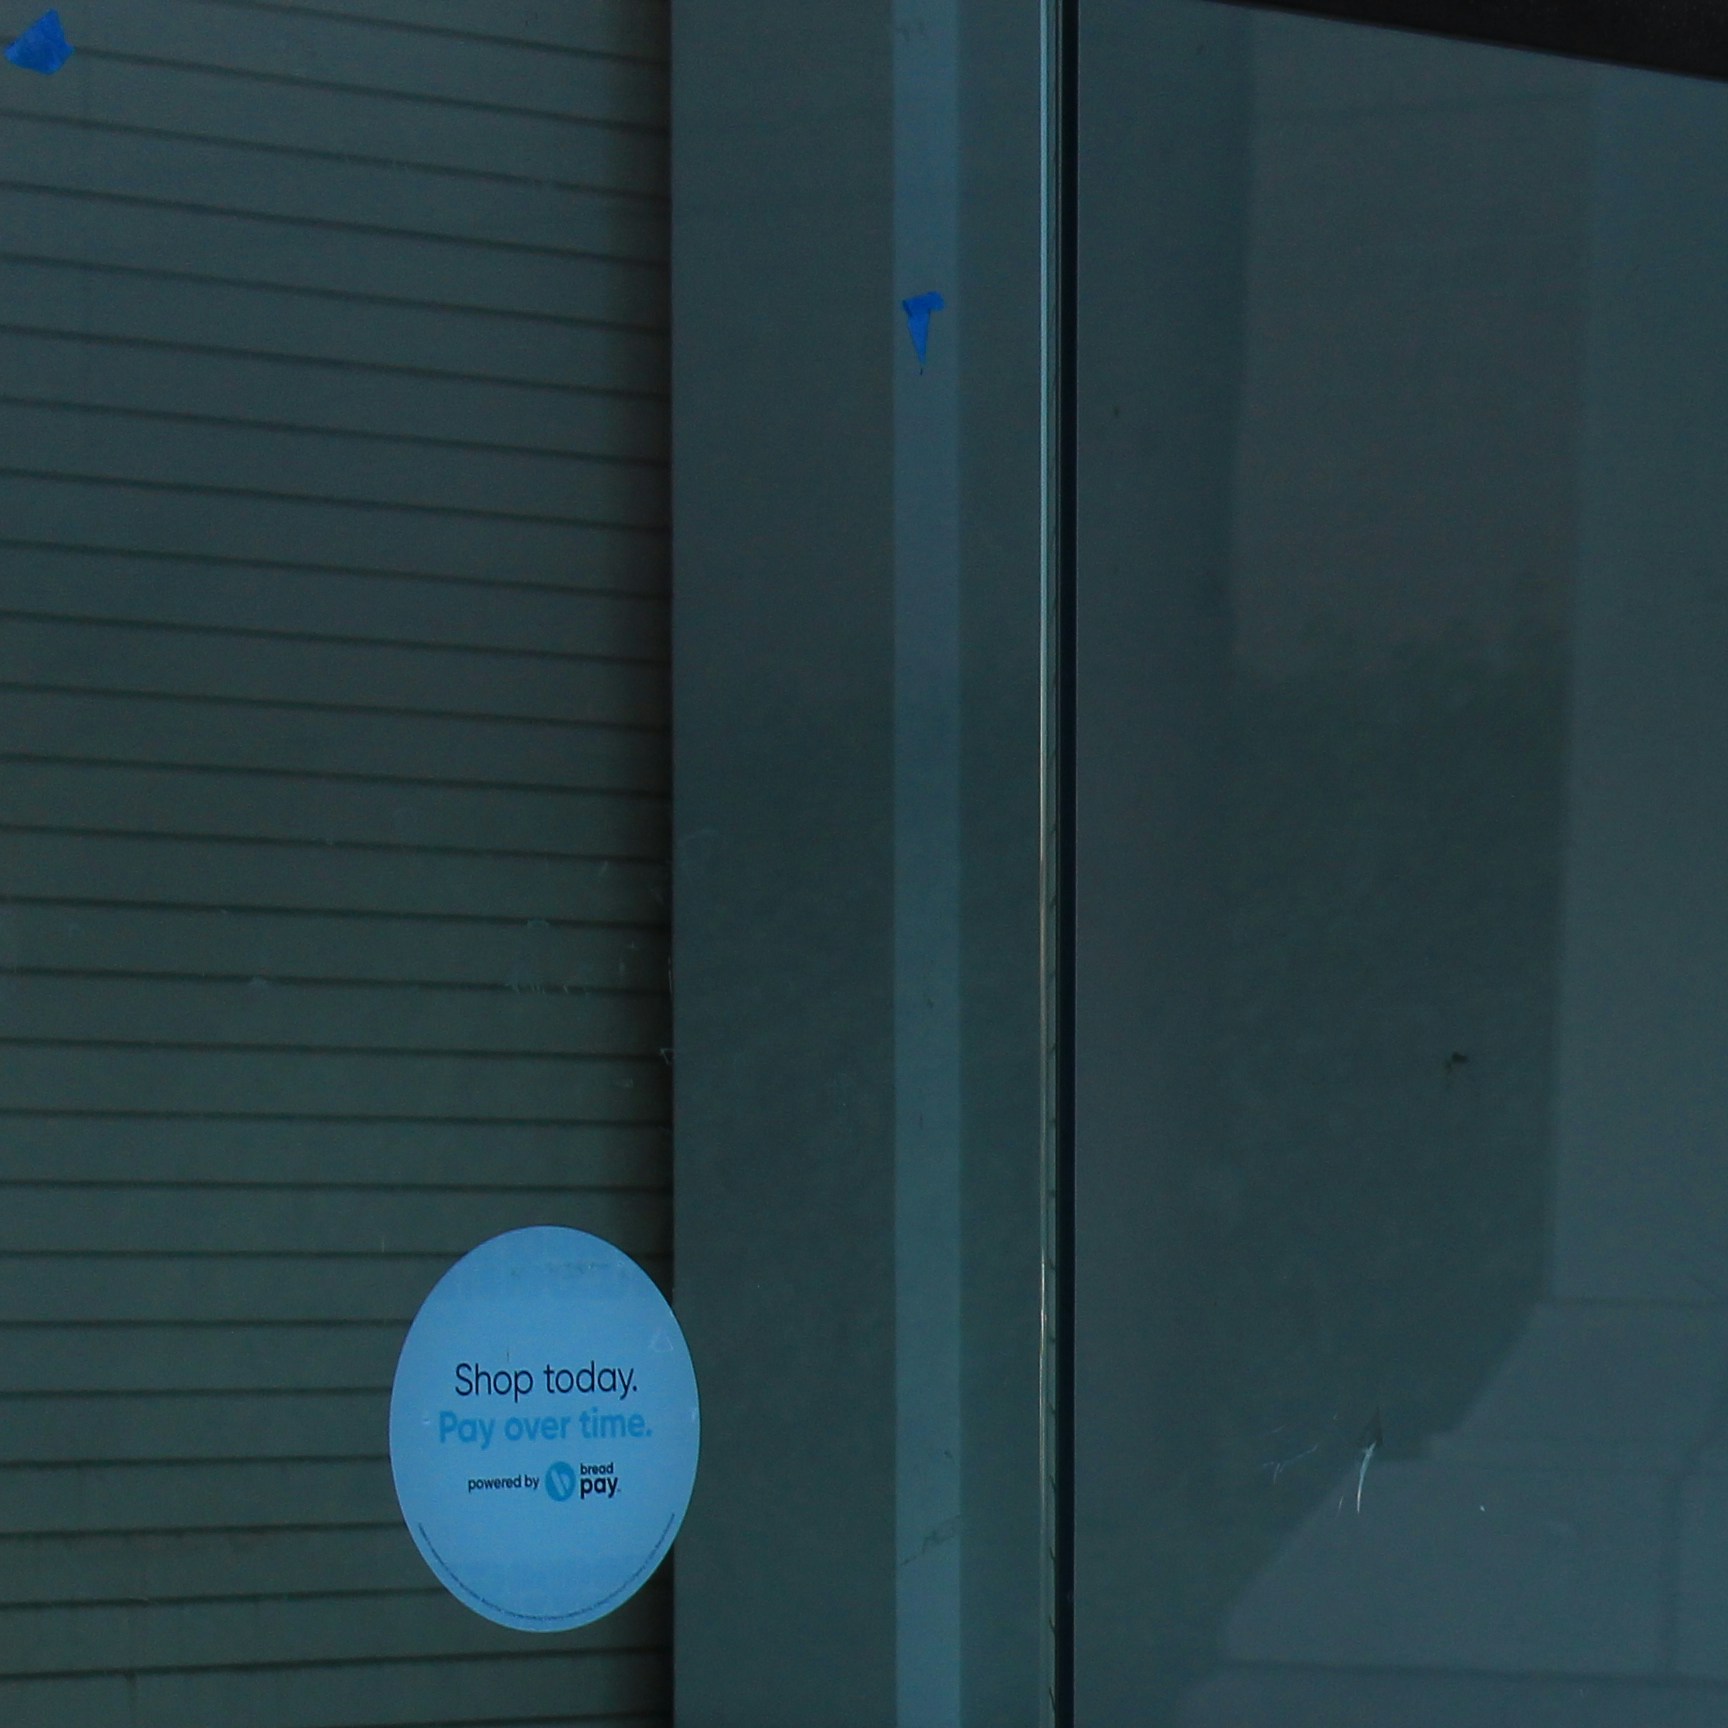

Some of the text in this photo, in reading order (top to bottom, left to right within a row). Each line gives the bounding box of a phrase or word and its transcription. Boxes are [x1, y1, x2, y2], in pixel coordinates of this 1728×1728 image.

[455, 1360, 638, 1404] Shop today.
[439, 1407, 653, 1451] Pay over time.
[580, 1462, 614, 1475] bread
[467, 1473, 540, 1493] powered by
[580, 1476, 618, 1499] pay
